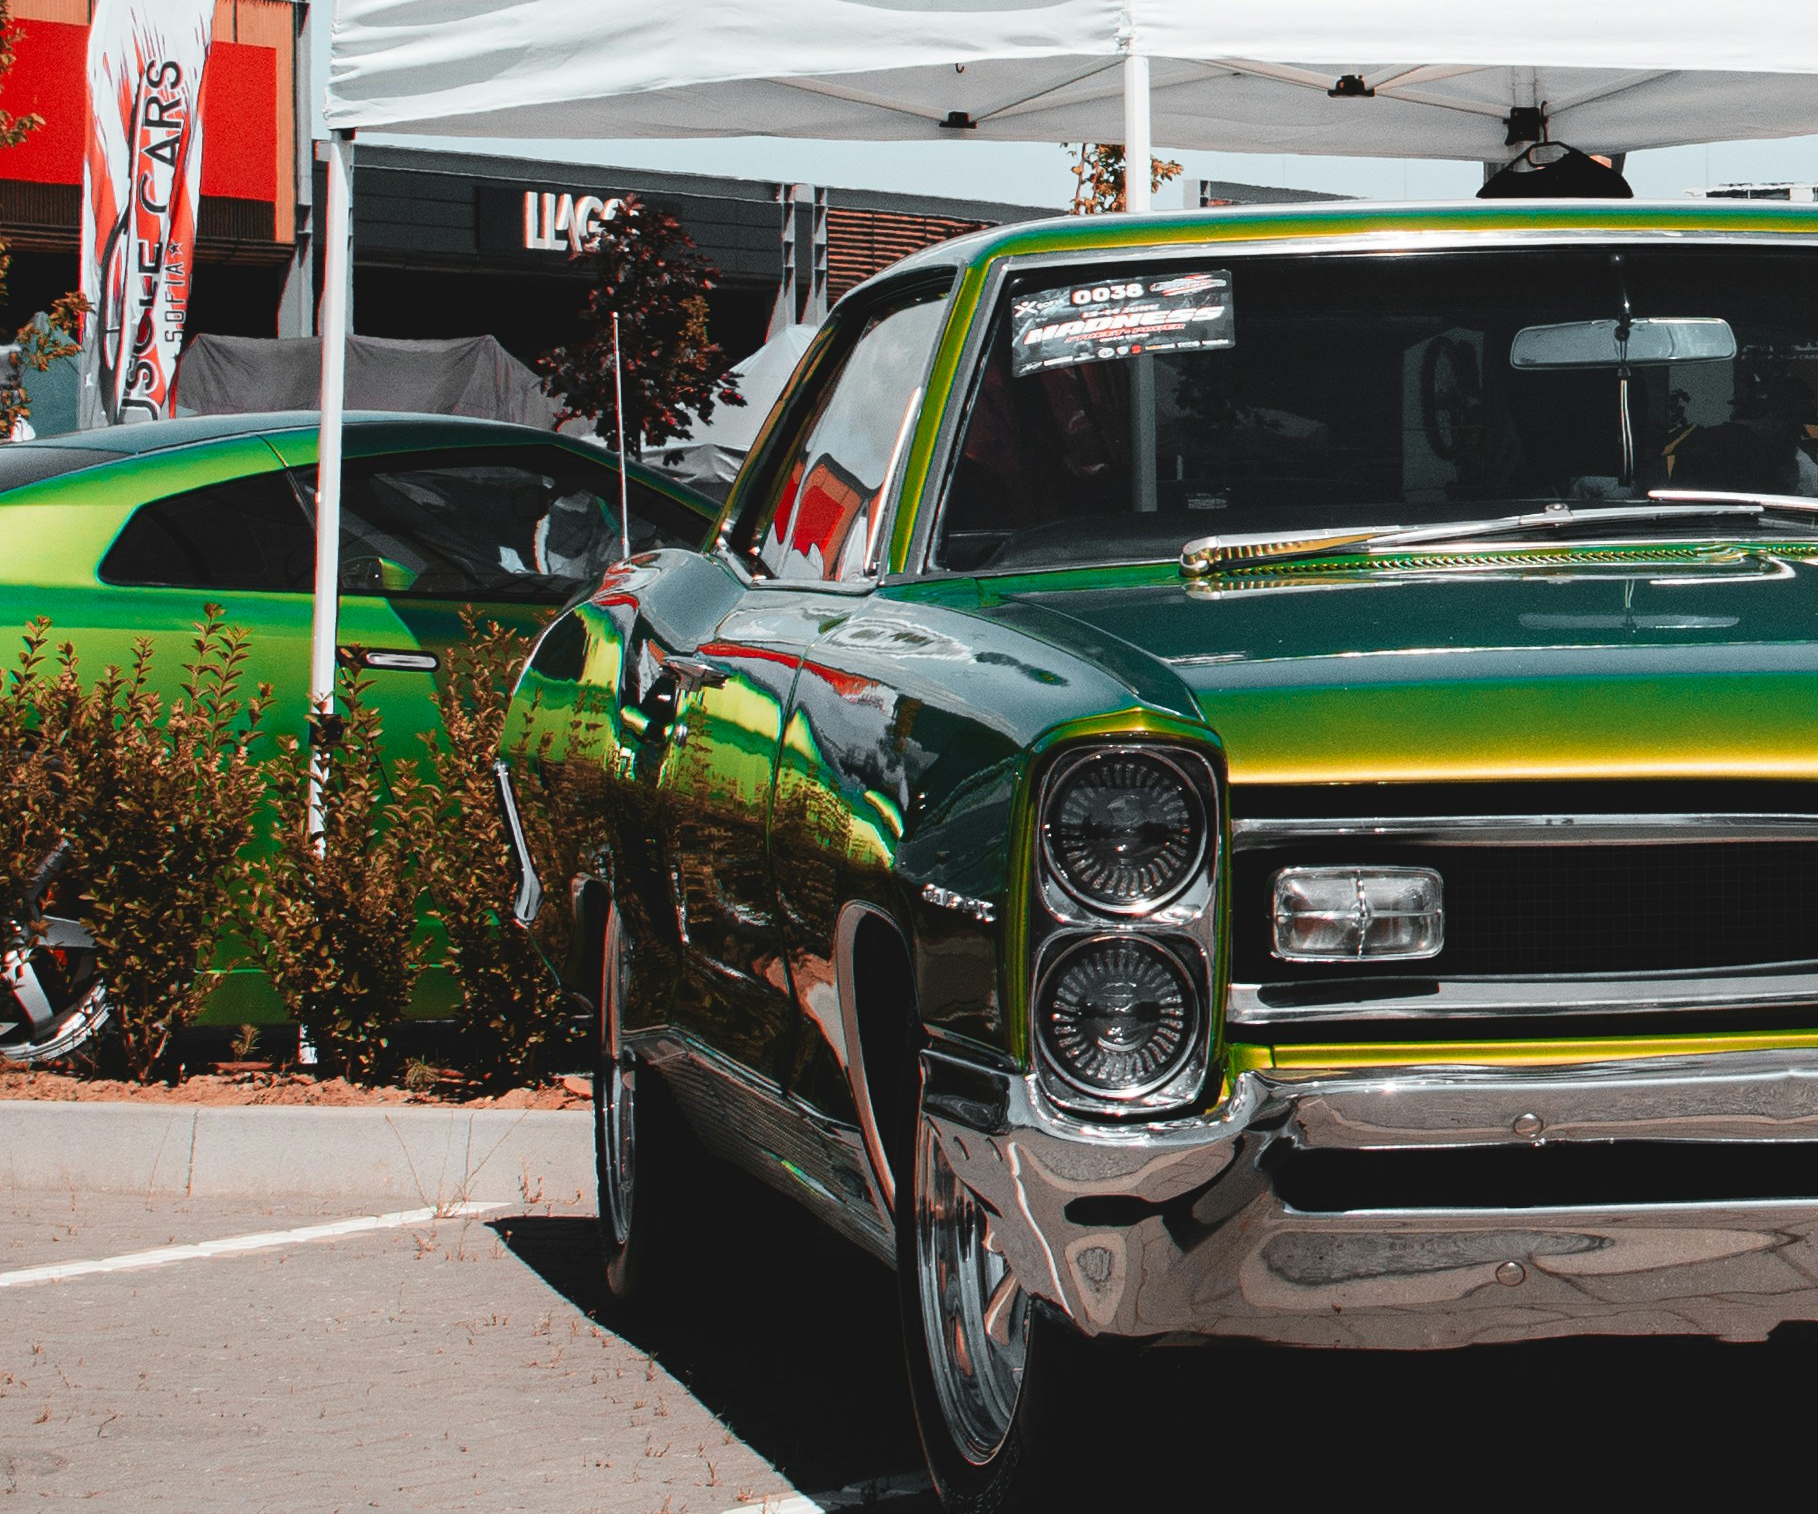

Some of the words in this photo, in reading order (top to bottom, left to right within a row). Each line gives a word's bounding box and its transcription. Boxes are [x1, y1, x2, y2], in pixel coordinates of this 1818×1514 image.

[164, 261, 186, 344] SOFIA
[1071, 282, 1145, 305] 0038
[1023, 305, 1226, 345] MADNESS
